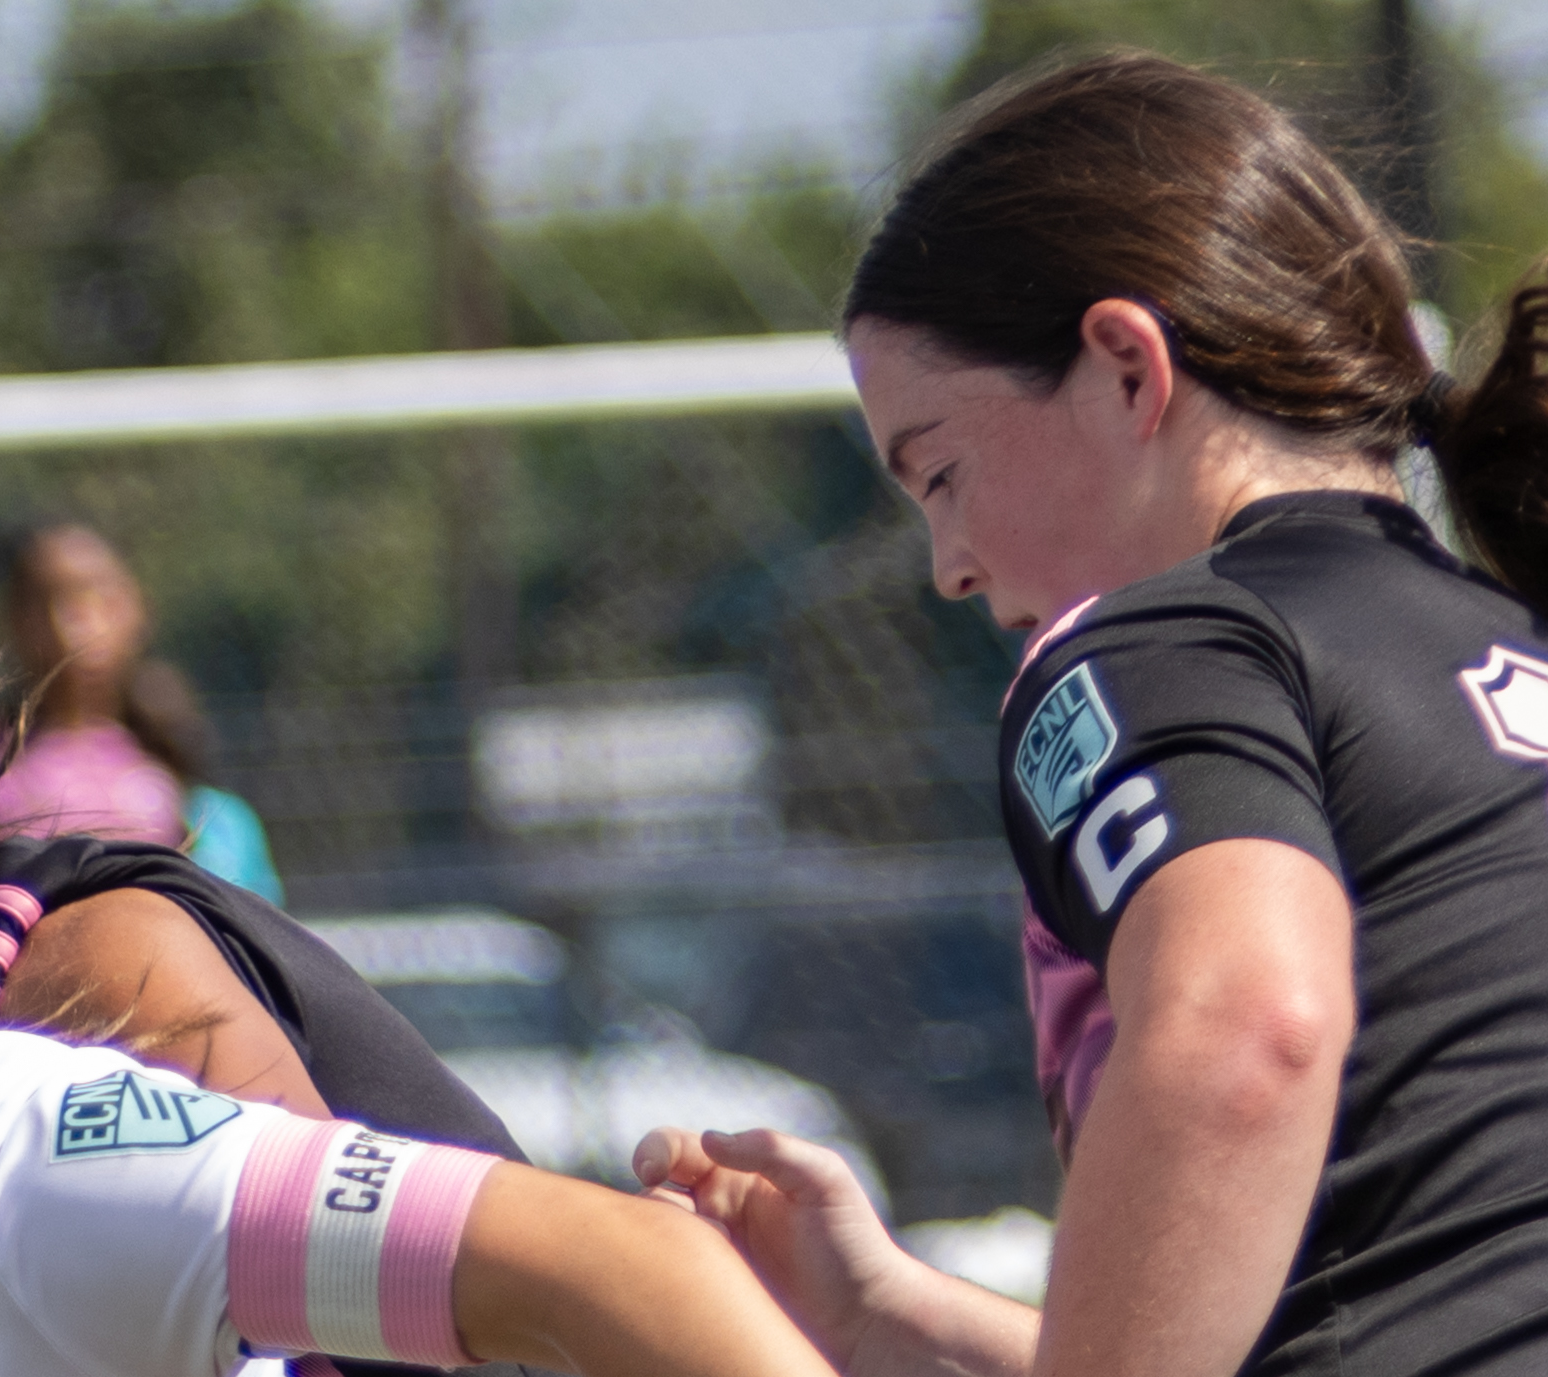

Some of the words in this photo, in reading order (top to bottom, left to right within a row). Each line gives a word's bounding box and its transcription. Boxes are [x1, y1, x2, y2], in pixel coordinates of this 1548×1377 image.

[1019, 679, 1088, 782] ECNL
[1075, 775, 1169, 912] C
[60, 1071, 127, 1151] ECNL
